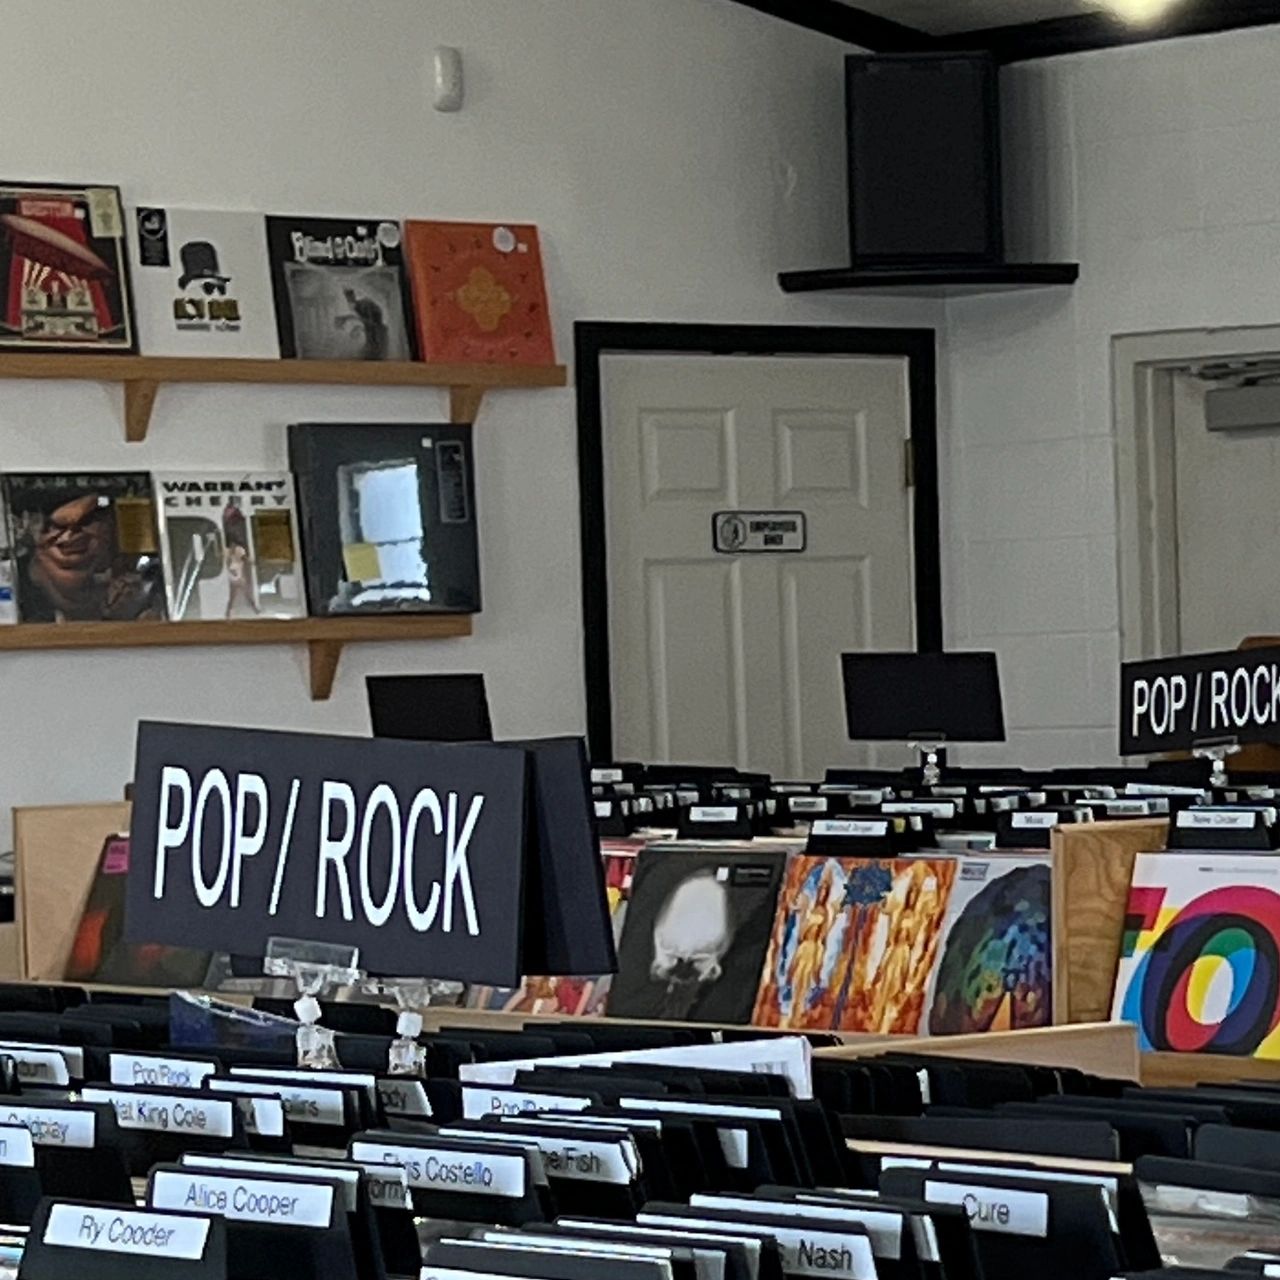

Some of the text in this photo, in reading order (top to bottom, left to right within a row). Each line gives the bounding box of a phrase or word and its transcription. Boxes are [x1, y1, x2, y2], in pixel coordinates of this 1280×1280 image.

[163, 480, 286, 493] WARRANT
[1132, 675, 1186, 737] POP
[154, 765, 268, 907] POP
[316, 780, 484, 936] ROCK
[138, 1100, 168, 1130] King
[173, 1103, 207, 1129] Cole
[425, 1156, 493, 1187] Costello
[563, 1145, 600, 1173] Fish
[184, 1182, 299, 1218] Alice Cooper
[963, 1193, 1011, 1226] Cure
[78, 1213, 176, 1248] Ry Cooder
[799, 1239, 853, 1272] Nash
